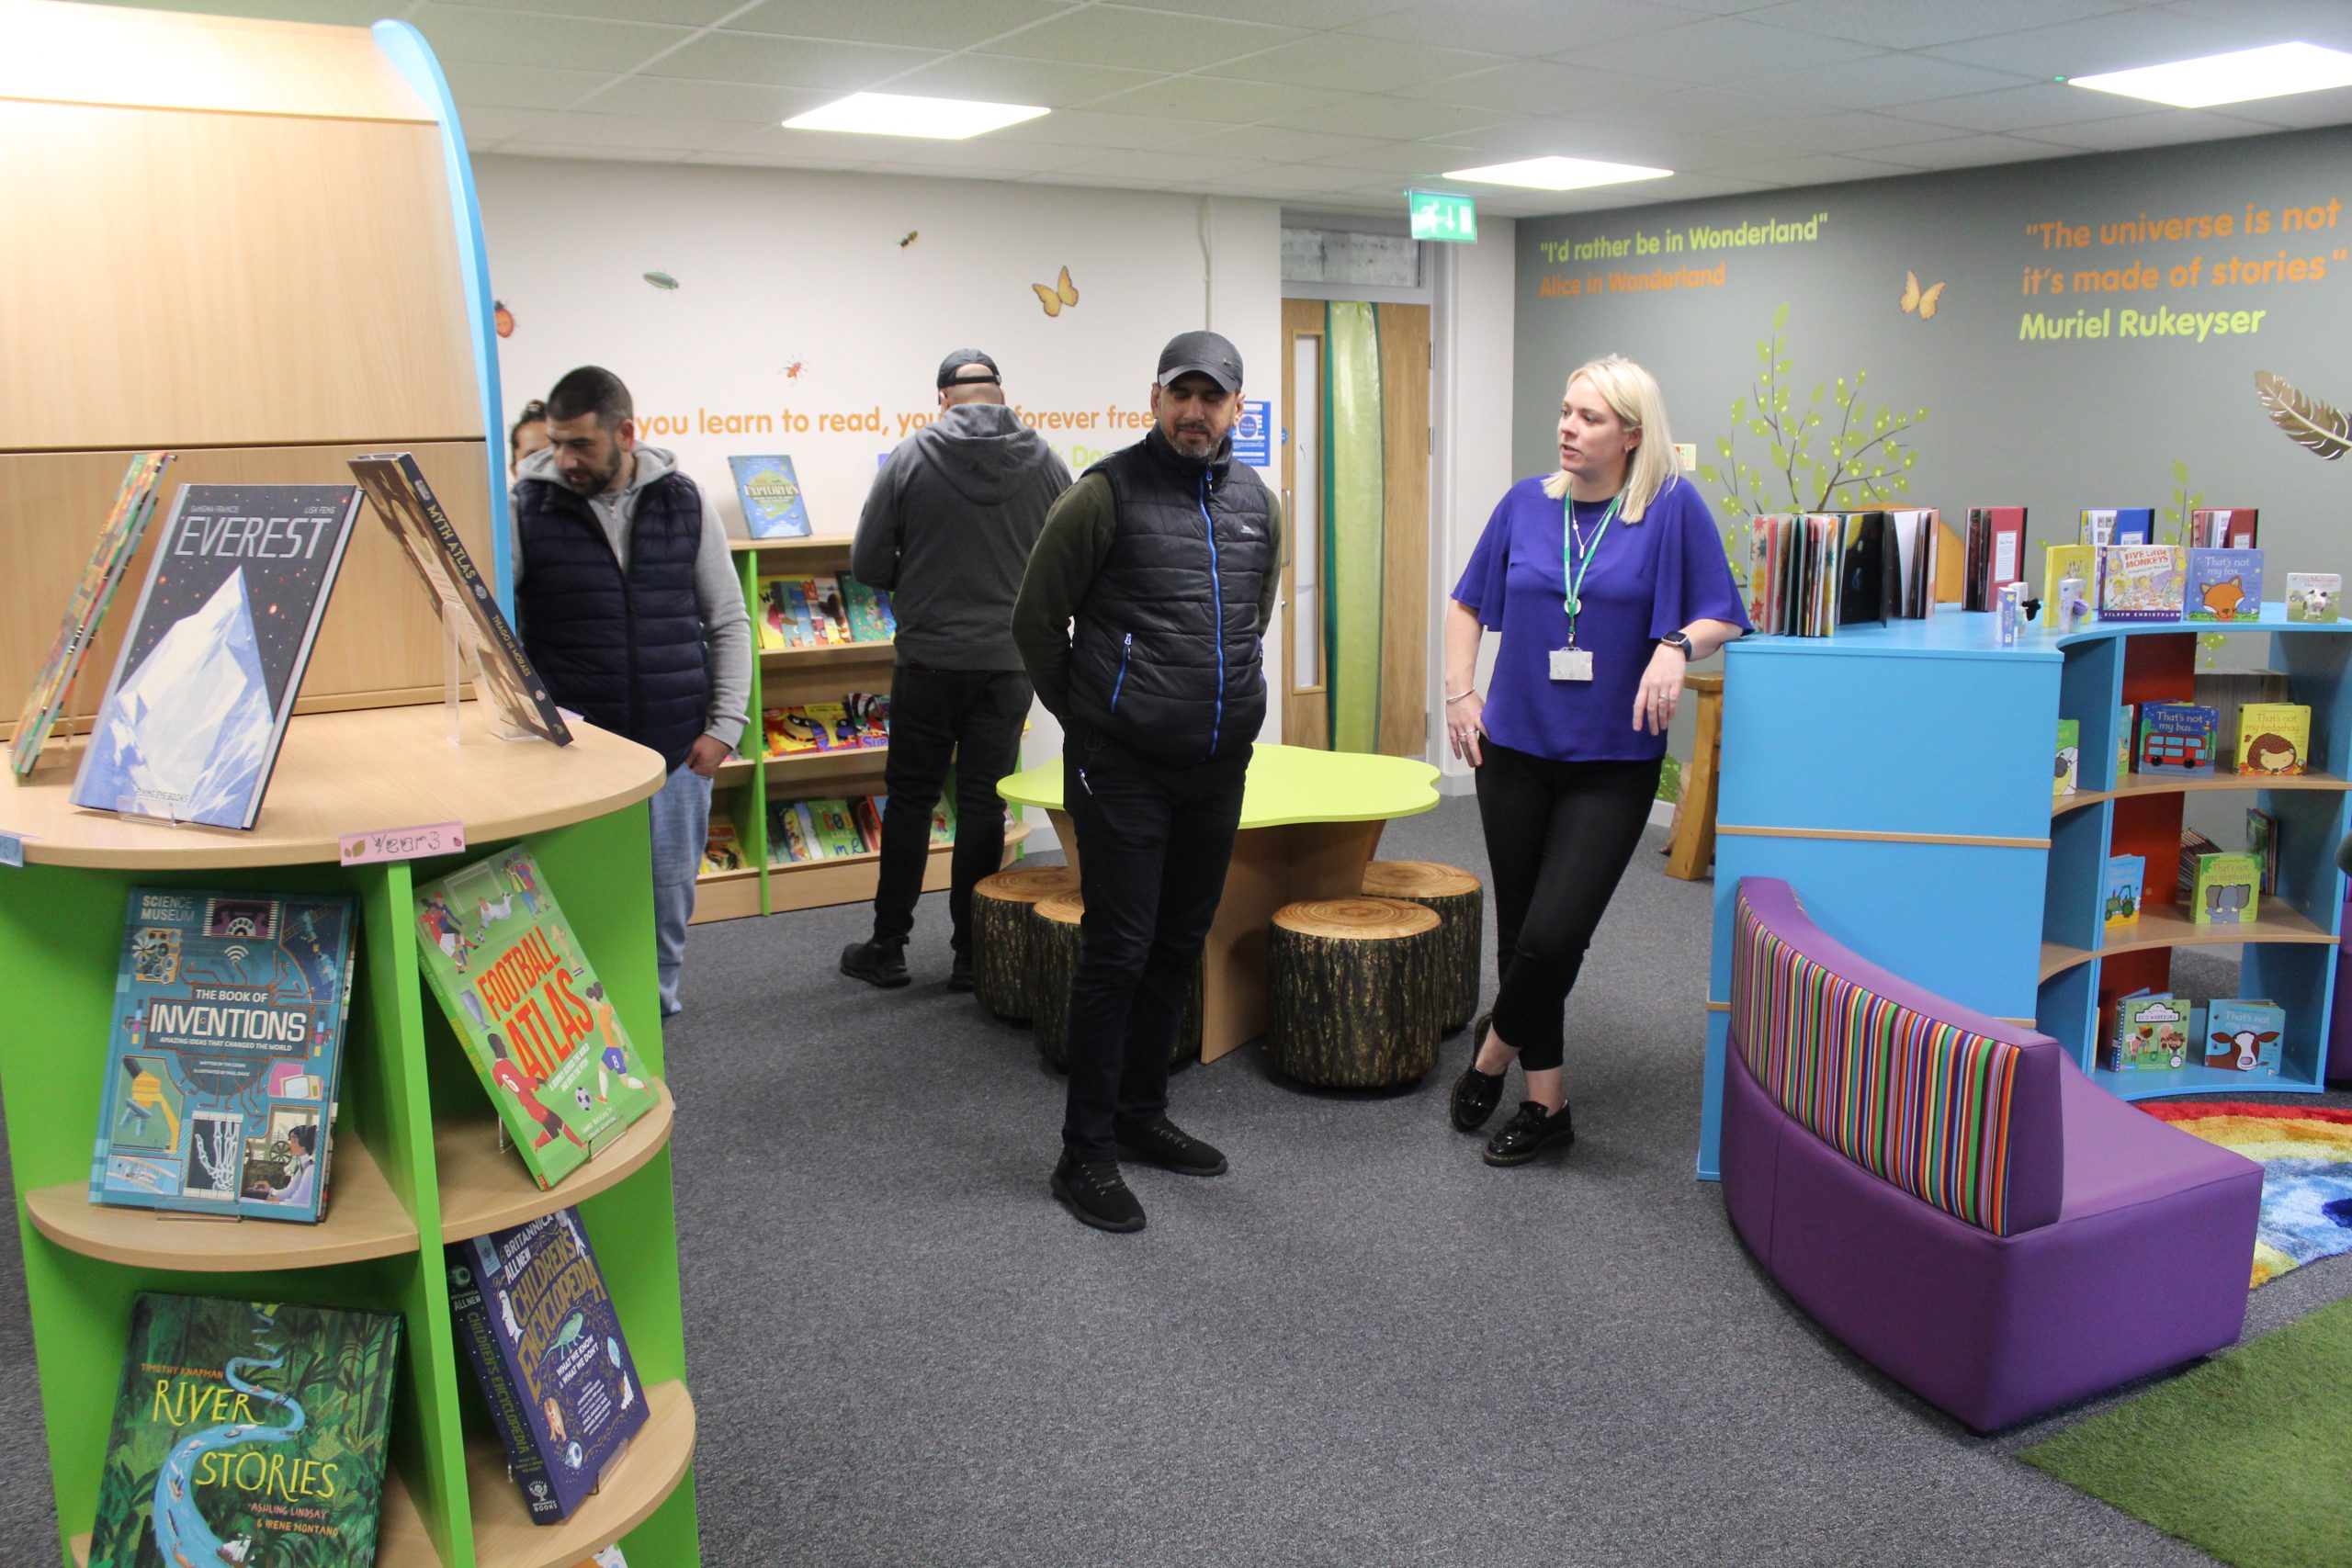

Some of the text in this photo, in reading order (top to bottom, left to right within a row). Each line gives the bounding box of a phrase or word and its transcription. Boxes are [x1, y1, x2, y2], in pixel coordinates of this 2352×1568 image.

[1574, 235, 1631, 260] rather
[1636, 231, 1659, 255] be
[1666, 229, 1683, 253] in
[1689, 212, 1828, 251] Wonderland"
[2026, 197, 2342, 250] "The universe is not
[1538, 262, 1726, 298] Alice in Wonderland
[2023, 267, 2064, 296] it's
[2074, 261, 2159, 293] made
[2168, 255, 2203, 288] of
[2019, 305, 2266, 343] Muriel Rukeyser
[636, 415, 688, 440] you
[698, 407, 773, 434] learn
[782, 408, 809, 433] to
[819, 406, 889, 436] read,
[1107, 404, 1155, 429] free
[743, 484, 799, 497] EXPLORERS
[174, 516, 333, 559] EVEREST
[427, 504, 476, 580] MYTH ATLAS
[2124, 551, 2143, 559] FIVE
[2126, 556, 2168, 569] MONKEYS
[2205, 557, 2250, 567] That's not
[2208, 567, 2221, 576] my
[492, 615, 511, 642] THIAGO
[512, 649, 531, 677] MORAES
[2157, 711, 2203, 723] That's not
[2159, 724, 2173, 733] my
[2256, 713, 2298, 723] That's not
[370, 830, 440, 854] Year 3
[2213, 863, 2234, 873] That's
[141, 908, 195, 921] MUSEUM
[142, 895, 195, 909] SCIENCE
[475, 926, 561, 1021] FOOTBALL
[196, 988, 268, 1003] THE BOOK OF
[150, 1003, 307, 1042] INVENTIONS
[504, 968, 594, 1092] ATLAS
[224, 1041, 254, 1049] CHANGED
[268, 1043, 292, 1052] WORLD
[611, 1055, 620, 1068] 8
[503, 1214, 554, 1257] BRITANNICA
[517, 1256, 608, 1405] ENCYCLOPEDIA
[556, 1334, 594, 1377] WHAT WE KNOW
[141, 1363, 223, 1379] TIMOTHY KNAPMAN
[561, 1365, 578, 1384] WHAT
[576, 1357, 585, 1370] WE
[467, 1312, 500, 1375] CHILDREN'S
[492, 1376, 529, 1455] ENCYCLOPEDIA
[153, 1379, 265, 1427] RIVER
[195, 1450, 338, 1503] STORIES
[290, 1505, 329, 1519] LINDSAY
[534, 1503, 558, 1513] BOOKS
[266, 1520, 291, 1531] IRENE
[293, 1523, 339, 1537] MONTANO
